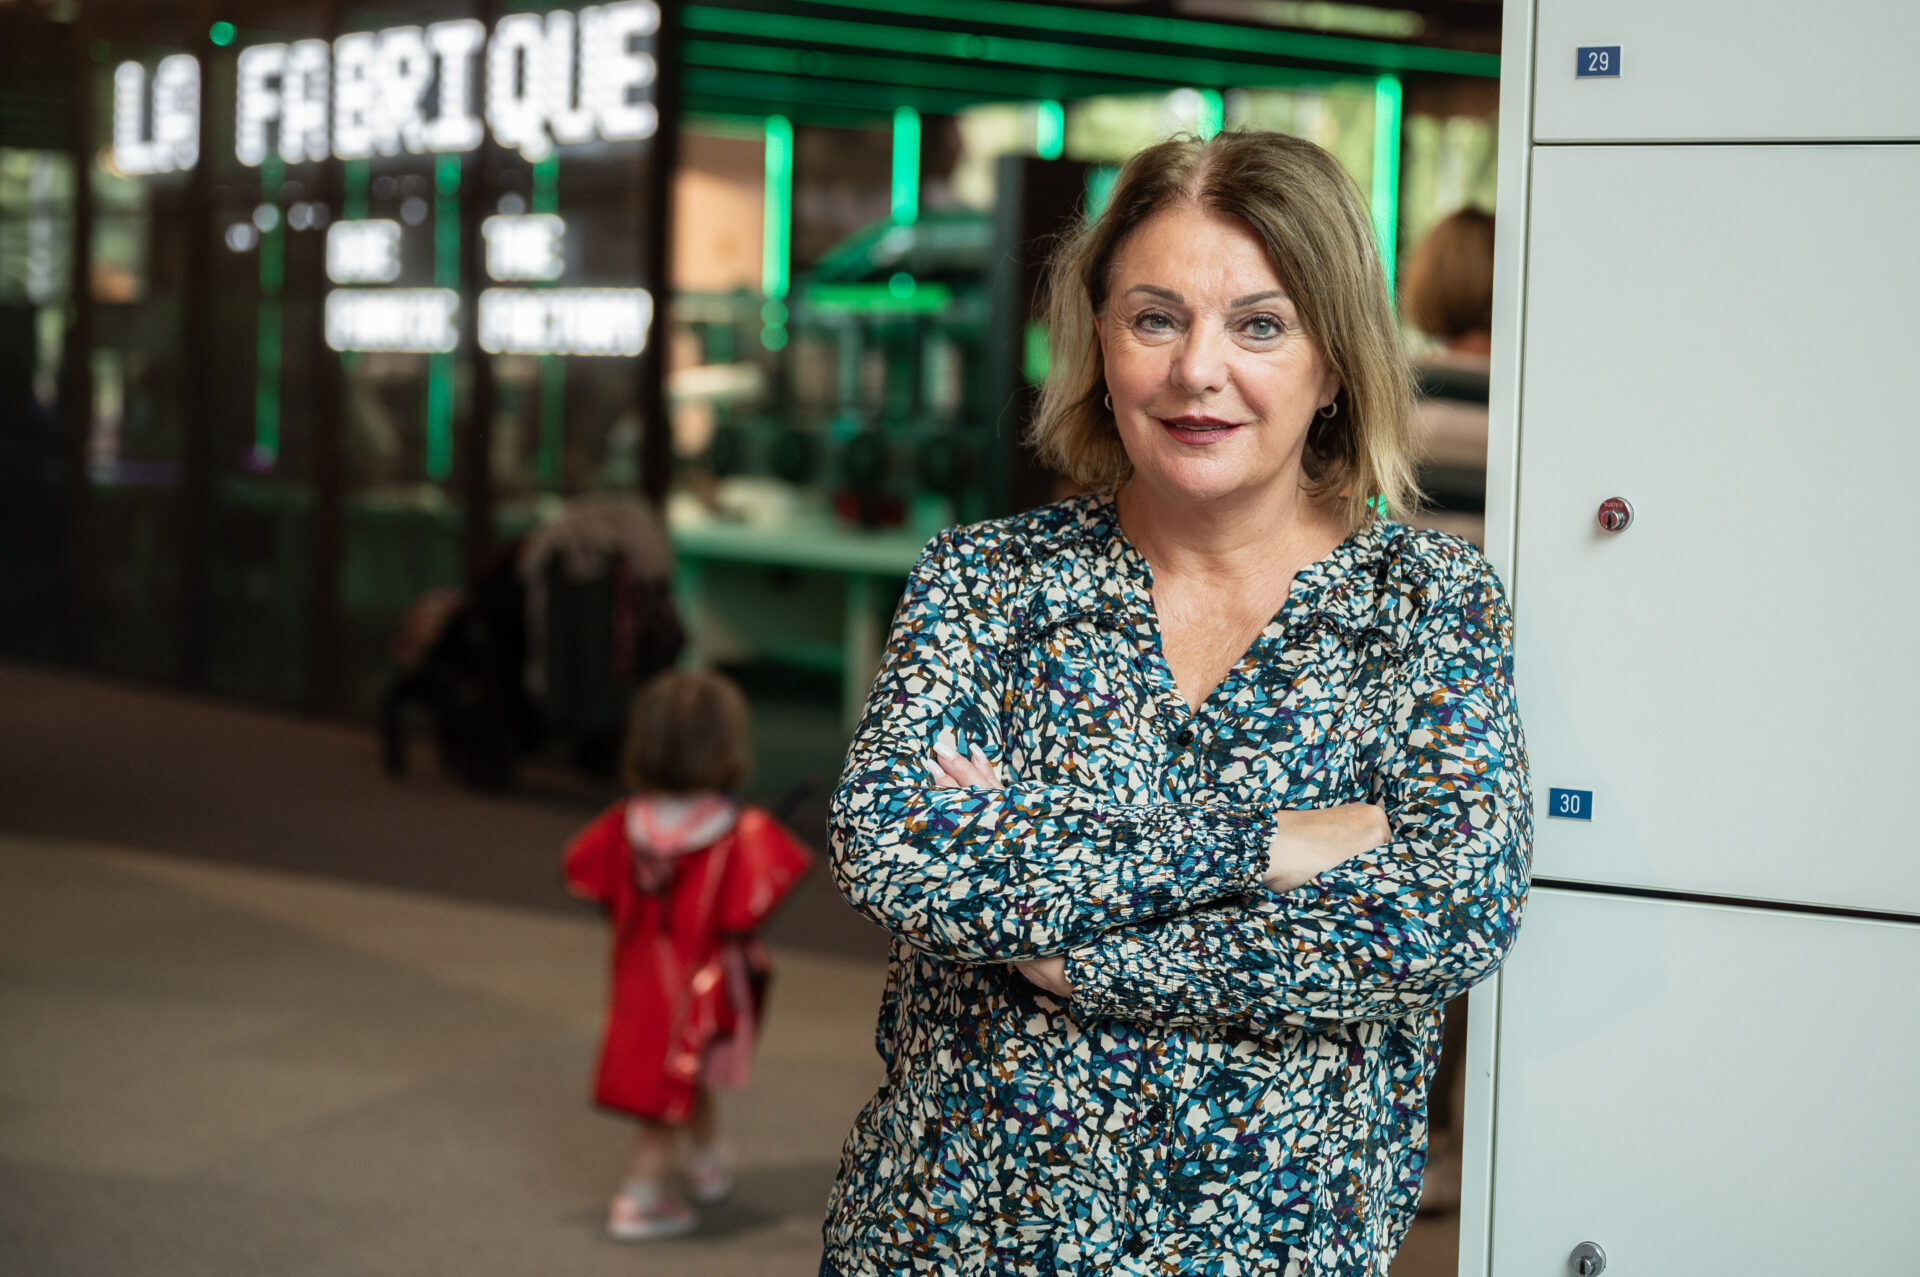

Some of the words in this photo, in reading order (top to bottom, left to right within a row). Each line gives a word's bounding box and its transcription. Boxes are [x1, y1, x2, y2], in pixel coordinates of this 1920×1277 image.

[1588, 51, 1609, 72] 29
[113, 54, 200, 174] LA
[235, 0, 660, 167] FABRIQUE
[1560, 793, 1581, 814] 30
